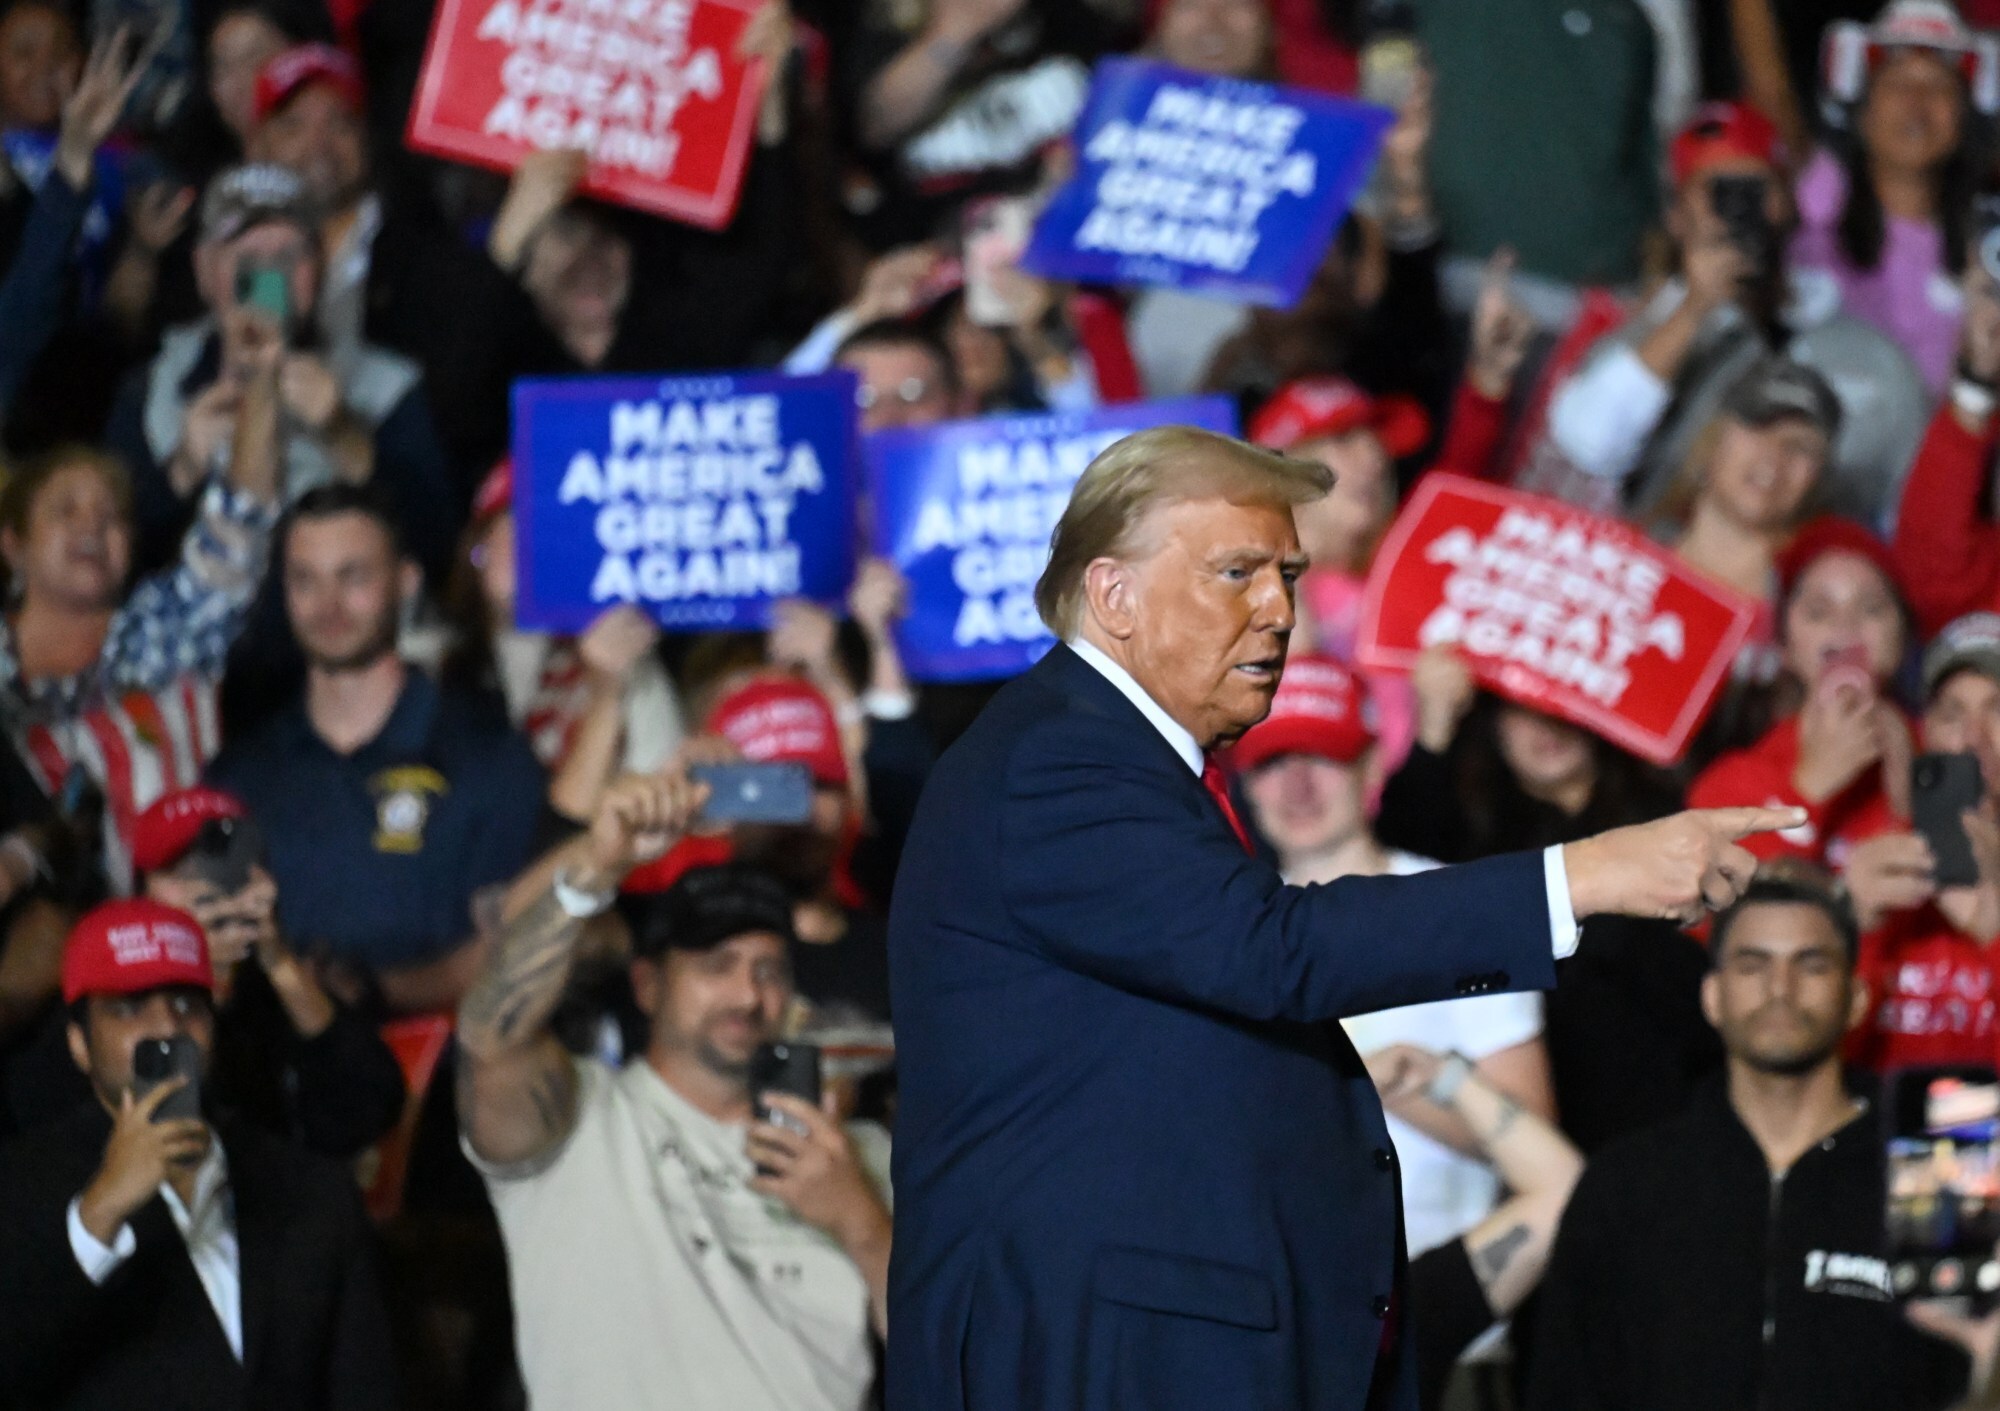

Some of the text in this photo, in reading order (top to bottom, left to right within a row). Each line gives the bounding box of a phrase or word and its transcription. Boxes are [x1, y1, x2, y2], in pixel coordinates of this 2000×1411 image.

[500, 52, 692, 136] GREAT
[1144, 82, 1308, 150] MAKE
[1083, 118, 1318, 197] AMERICA
[1097, 164, 1275, 232] GREAT
[1073, 204, 1261, 273] AGAIN!
[609, 395, 781, 450] MAKE
[558, 440, 827, 506] AMERICA
[594, 494, 799, 555] GREAT
[1496, 506, 1669, 606] MAKE
[590, 541, 801, 604] AGAIN!
[1424, 525, 1685, 664] AMERICA
[1444, 574, 1646, 668] GREAT
